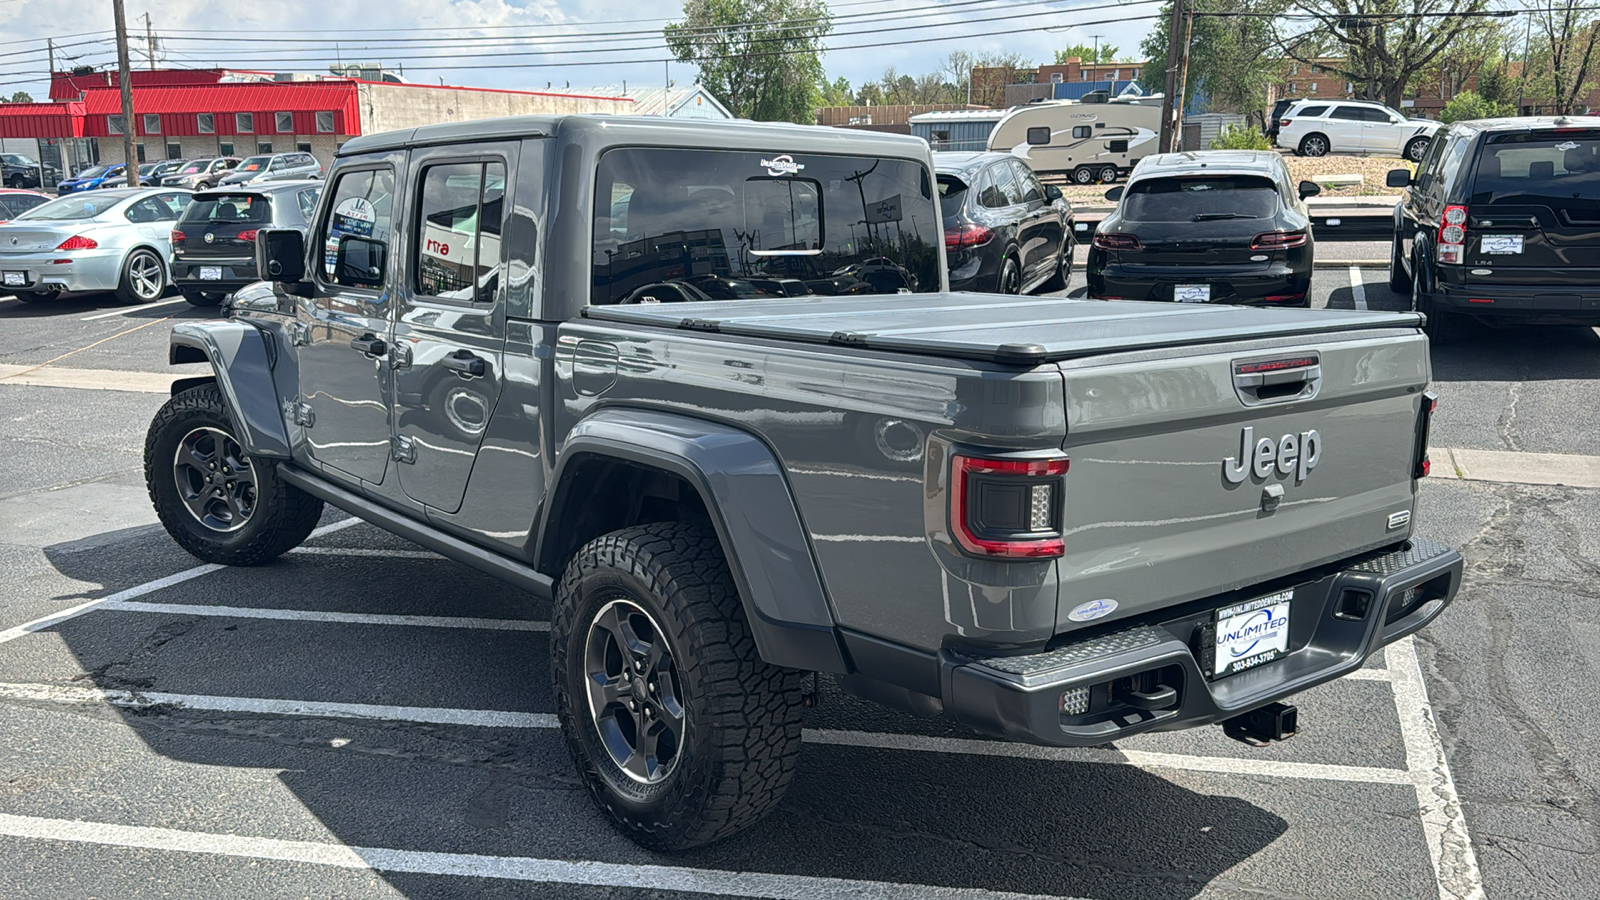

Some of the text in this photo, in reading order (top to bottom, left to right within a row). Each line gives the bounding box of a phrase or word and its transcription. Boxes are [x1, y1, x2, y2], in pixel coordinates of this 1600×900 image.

[1222, 426, 1321, 484] Jeep
[1216, 616, 1288, 645] UNLIMITED
[1232, 652, 1275, 672] 303-934-3705
